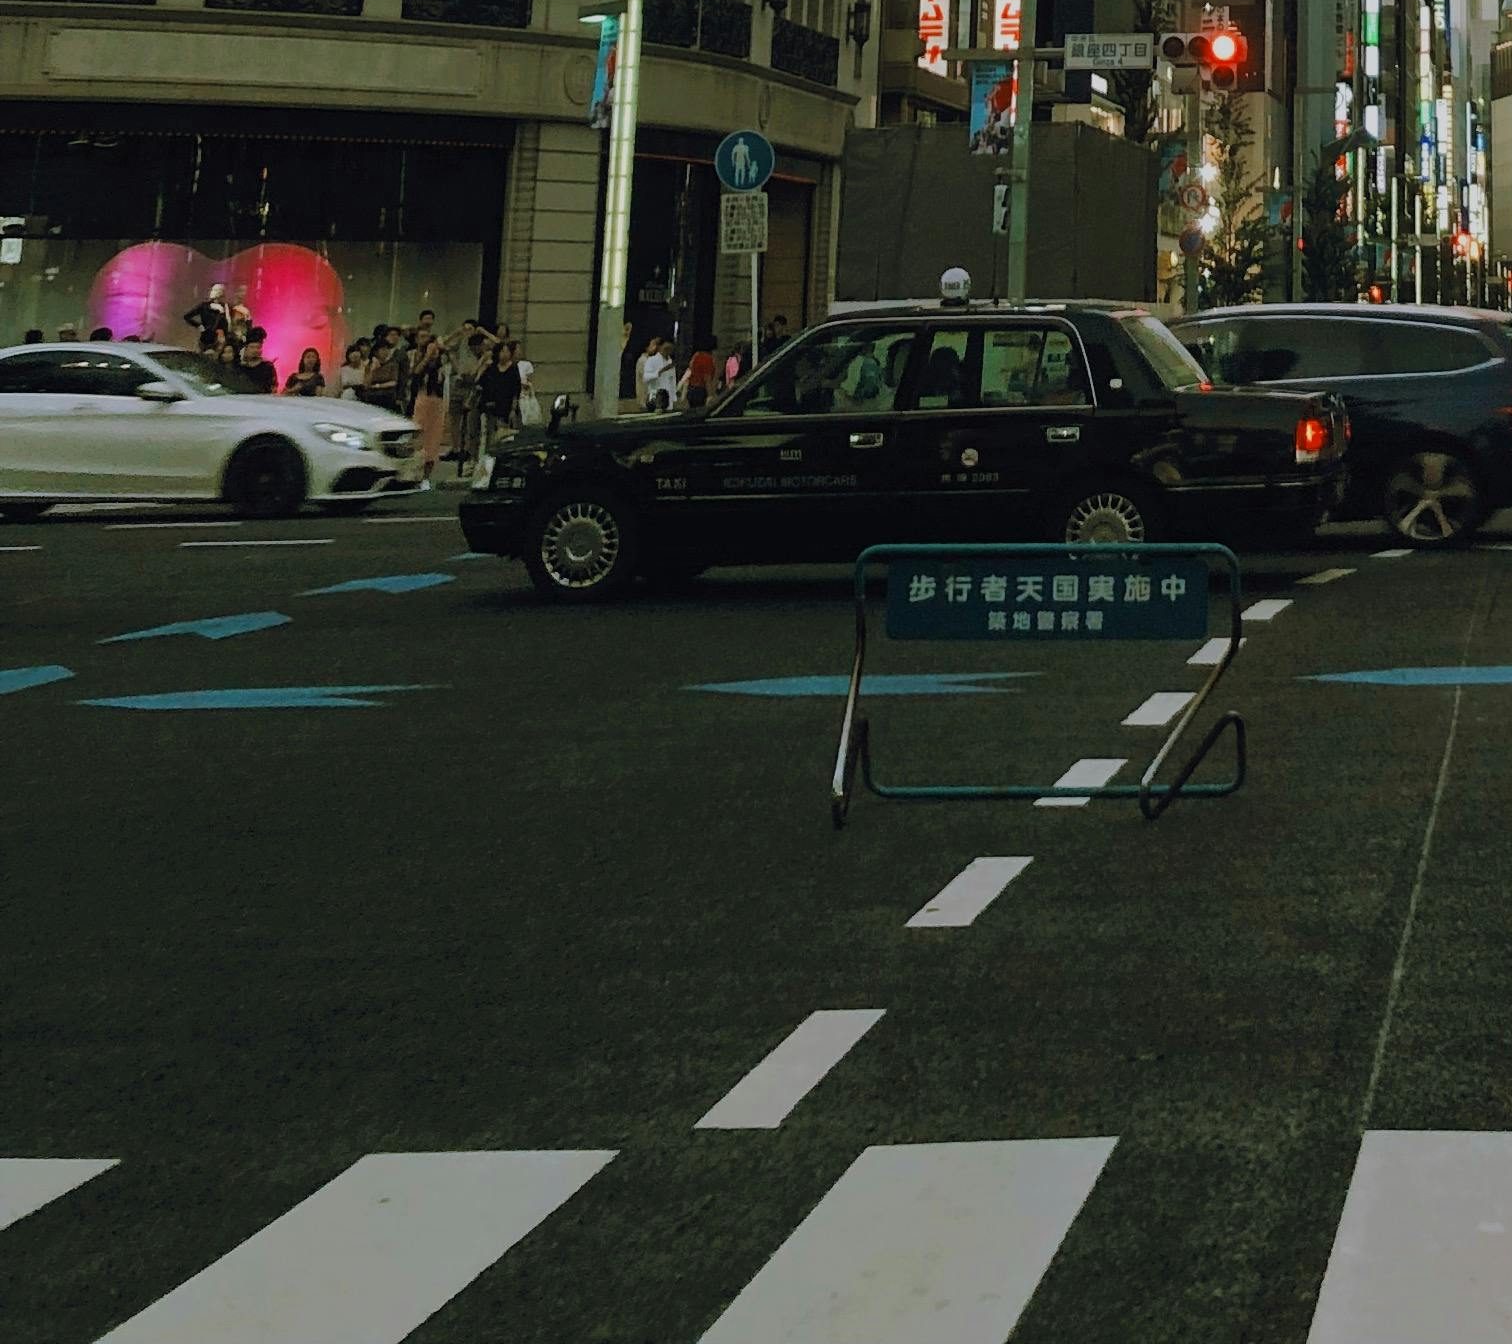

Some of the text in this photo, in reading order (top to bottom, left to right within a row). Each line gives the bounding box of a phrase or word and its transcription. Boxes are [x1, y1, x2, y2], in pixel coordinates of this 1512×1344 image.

[909, 574, 1187, 602] 歩行者天国実施中
[987, 611, 1104, 631] 築地警察署
